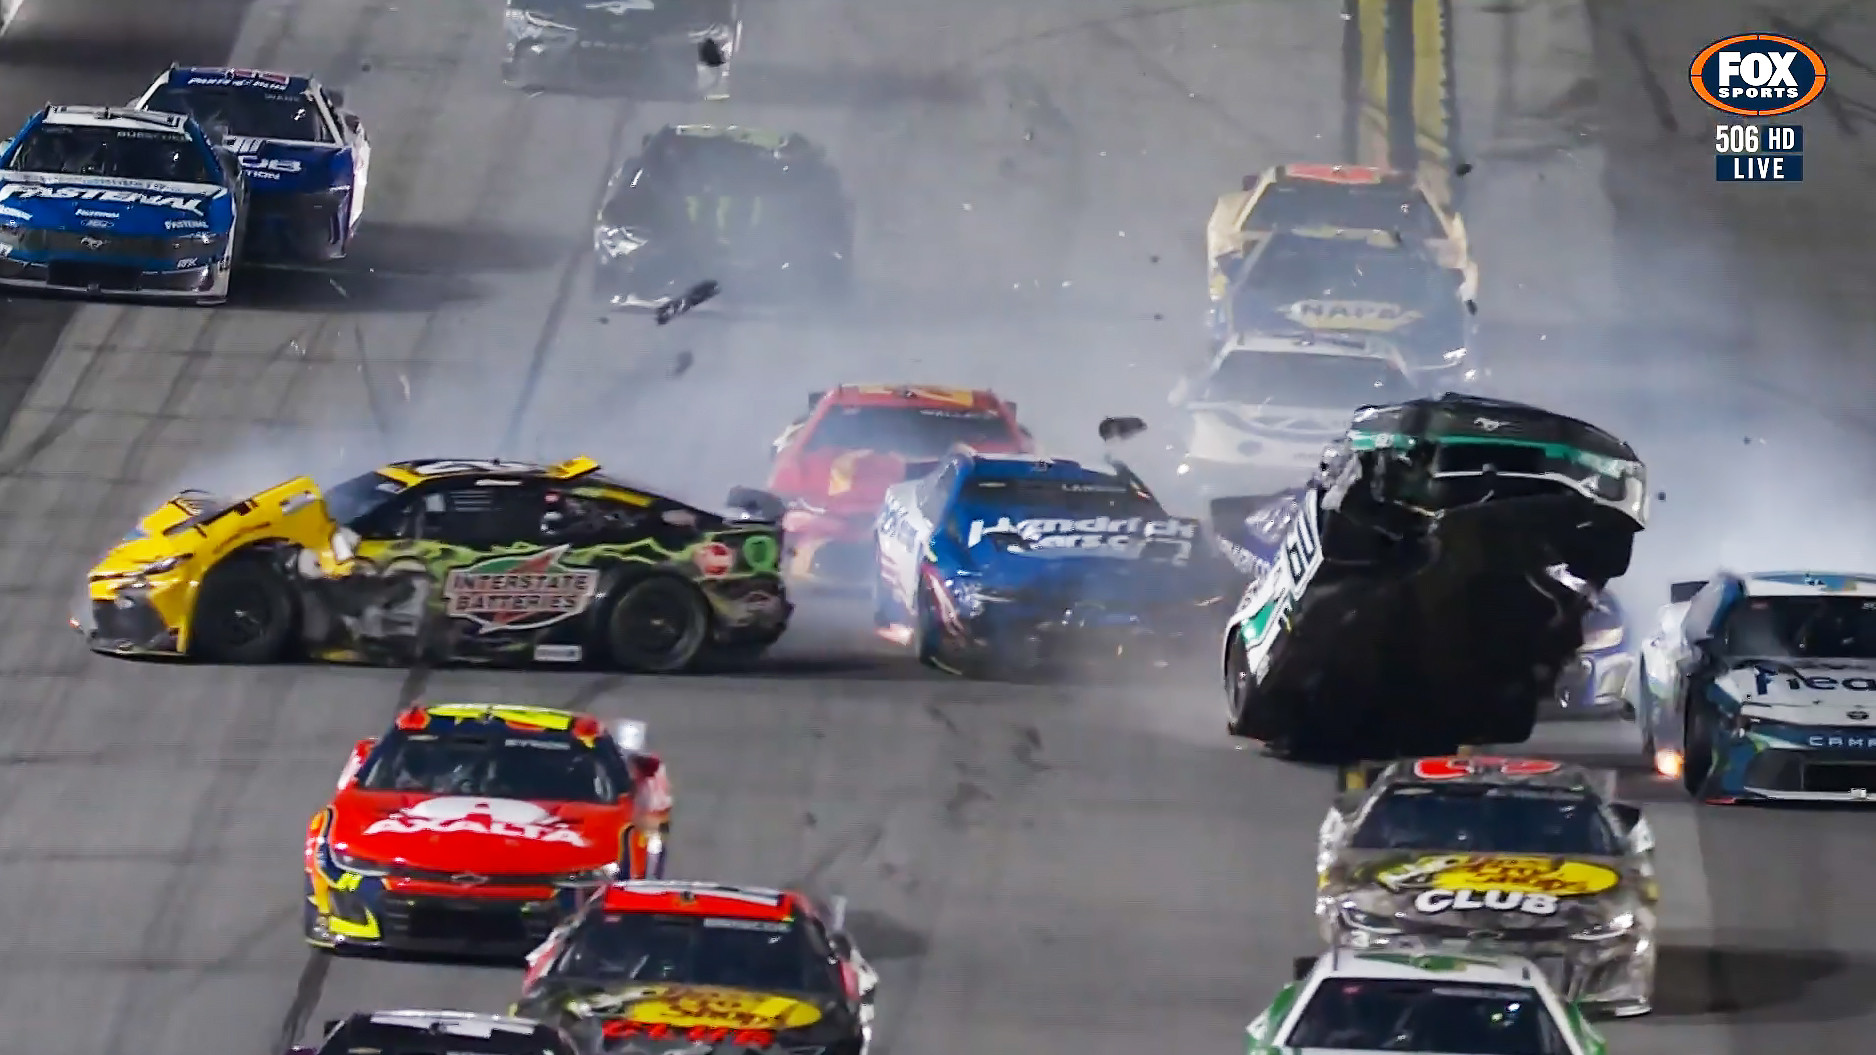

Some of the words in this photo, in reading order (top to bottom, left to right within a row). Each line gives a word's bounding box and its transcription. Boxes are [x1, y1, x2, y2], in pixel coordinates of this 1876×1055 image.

[0, 182, 205, 217] FASTENAL
[453, 564, 589, 590] INTERSTATE
[456, 594, 576, 611] BATTERIES
[362, 815, 592, 849] AXALTA
[1414, 888, 1558, 915] CLUB
